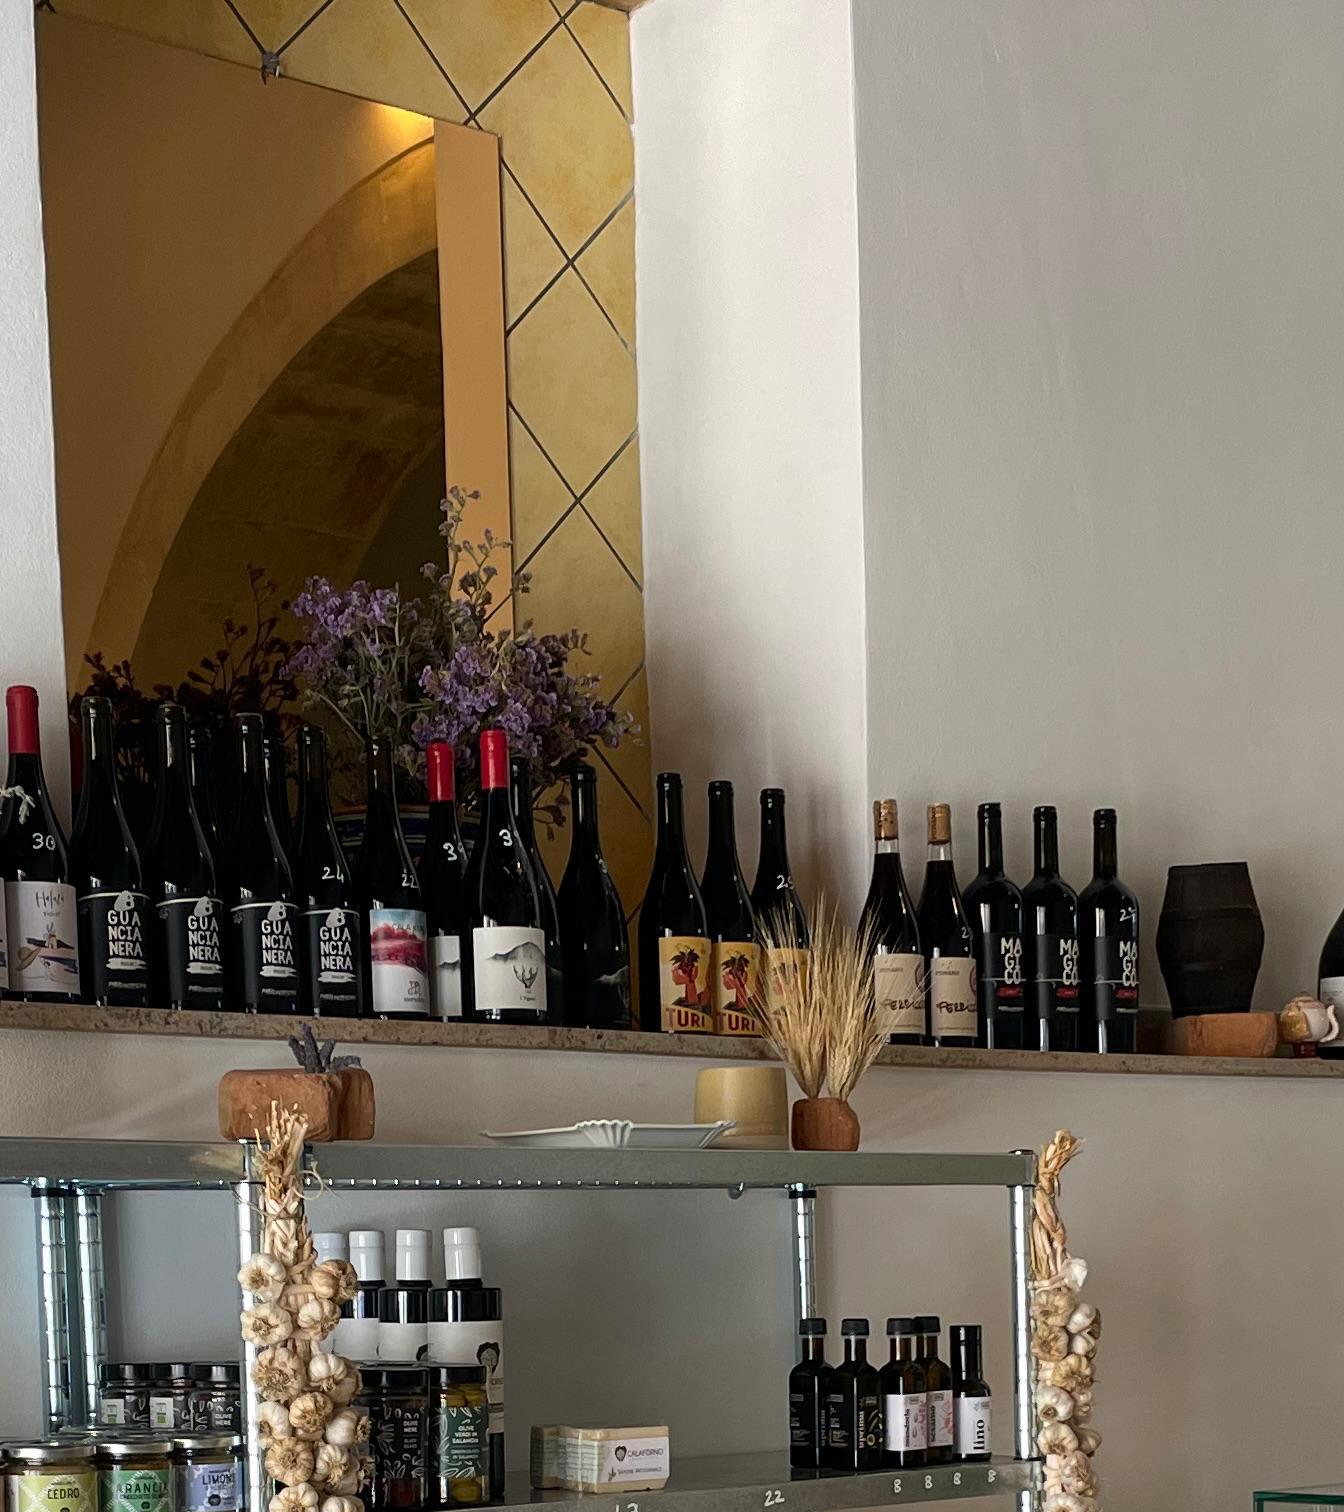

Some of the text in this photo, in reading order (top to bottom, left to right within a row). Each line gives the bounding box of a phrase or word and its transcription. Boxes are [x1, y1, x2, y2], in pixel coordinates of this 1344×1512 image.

[32, 832, 56, 850] 30
[322, 866, 344, 884] 24
[108, 910, 141, 926] GUA
[108, 926, 142, 941] NCIA
[320, 926, 351, 942] GUA
[108, 941, 143, 957] NERA
[320, 941, 352, 956] NCIA
[321, 955, 353, 971] NERA
[665, 1007, 705, 1029] TURI
[716, 1012, 754, 1032] TURI
[973, 1420, 985, 1450] lino
[47, 1487, 80, 1499] CEDRO
[764, 1490, 784, 1506] 22
